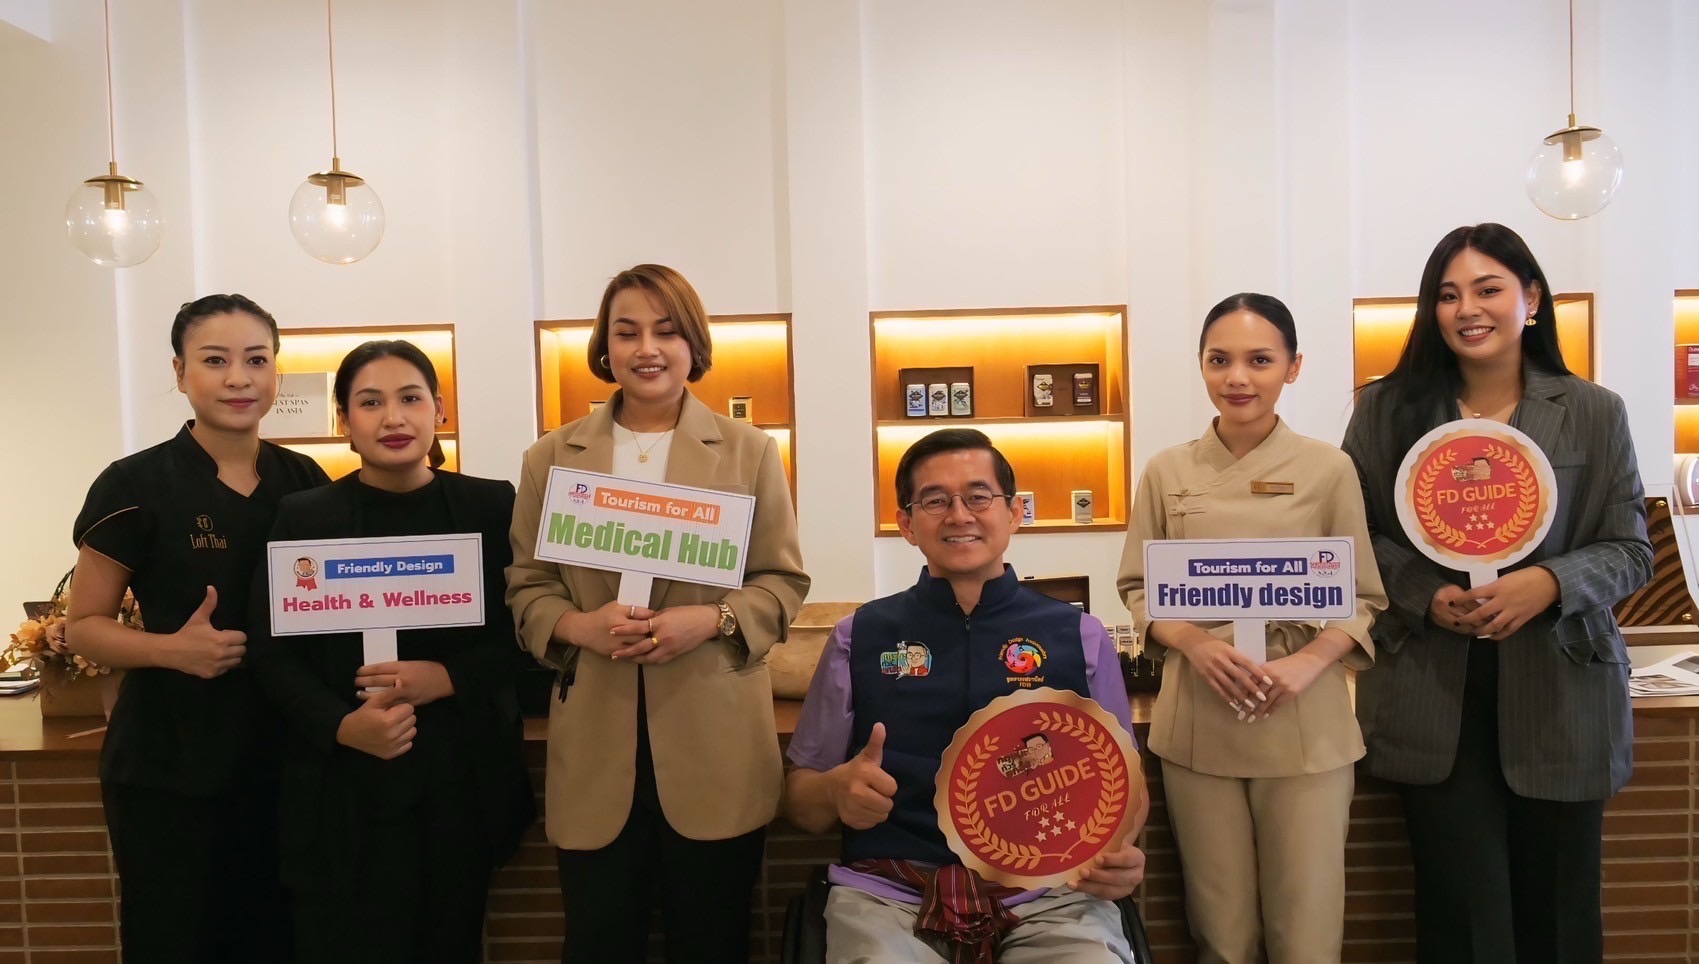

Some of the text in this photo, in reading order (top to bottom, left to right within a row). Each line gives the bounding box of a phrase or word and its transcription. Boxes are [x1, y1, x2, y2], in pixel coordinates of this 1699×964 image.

[1436, 482, 1517, 505] FD GUIDE
[601, 491, 661, 513] Tourism
[665, 501, 689, 517] for
[691, 506, 716, 521] All
[190, 533, 228, 549] Loft Thai
[547, 512, 738, 571] Medical Hub
[338, 560, 443, 574] Friendly Design
[1194, 561, 1251, 574] Tourism
[1255, 561, 1277, 573] for
[1282, 561, 1303, 573] All
[1318, 551, 1335, 563] FD
[283, 590, 472, 612] Health & Wellness
[1158, 583, 1343, 609] Friendly design
[984, 790, 1017, 818] FD
[1020, 757, 1096, 802] GUIDE
[1024, 793, 1071, 820] FOR ALL
